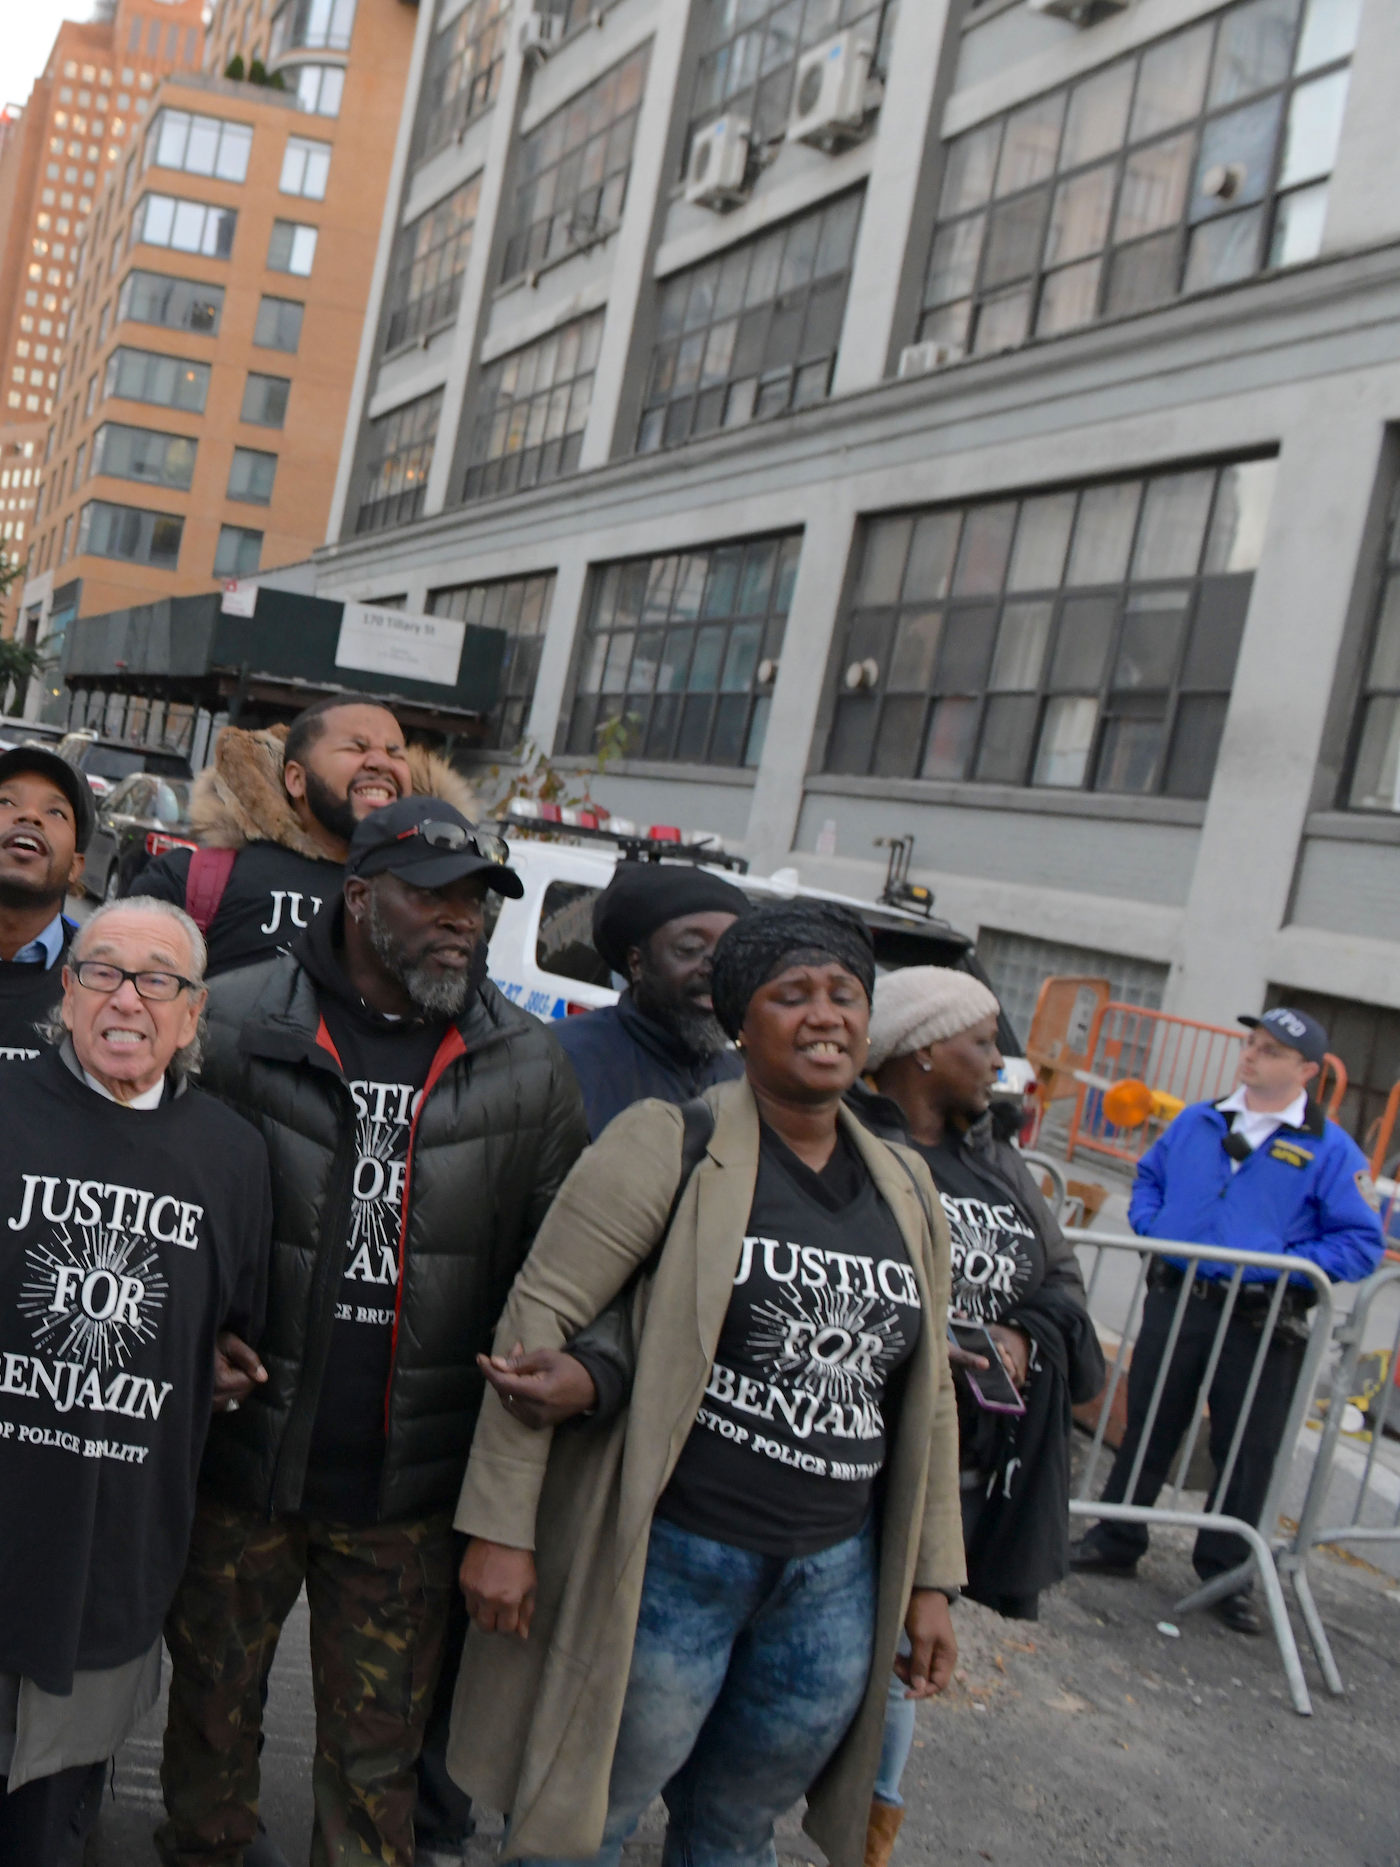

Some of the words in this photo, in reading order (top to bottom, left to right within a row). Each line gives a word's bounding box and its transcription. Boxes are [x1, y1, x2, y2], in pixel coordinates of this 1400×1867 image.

[7, 1174, 204, 1250] JUSTICE
[48, 1264, 145, 1327] FOR
[733, 1236, 921, 1309] JUSTICE
[781, 1318, 884, 1378] FOR
[18, 1425, 80, 1454] POLICE
[696, 1407, 749, 1444] STOP
[751, 1433, 827, 1477] POLICE
